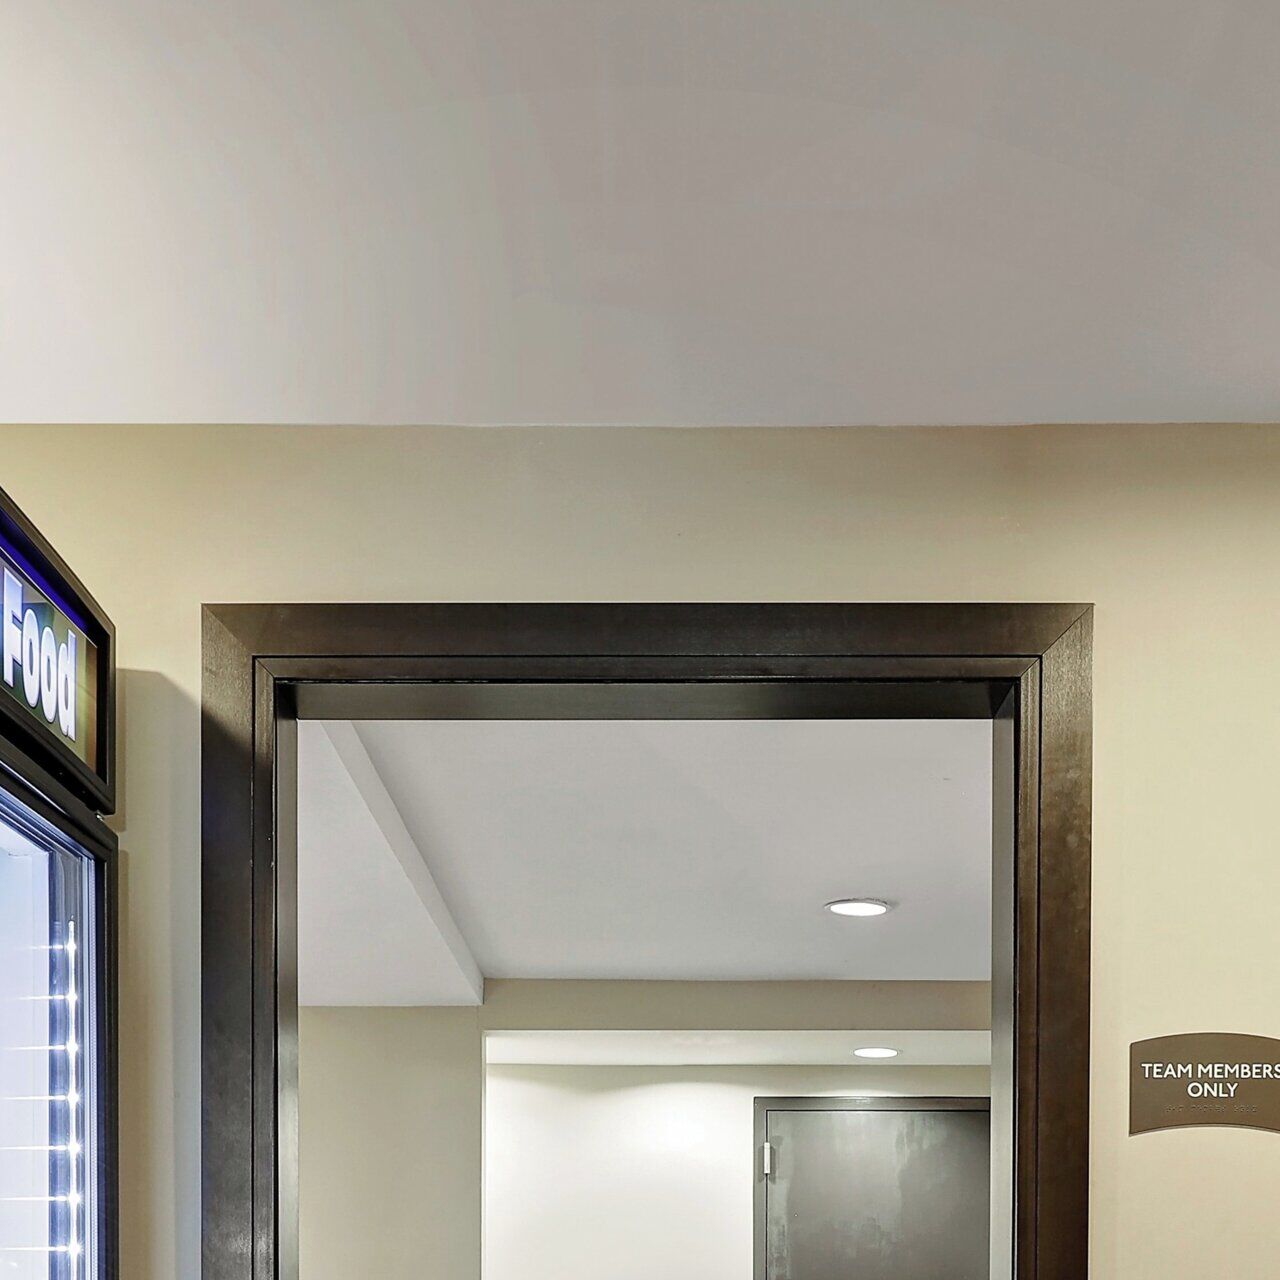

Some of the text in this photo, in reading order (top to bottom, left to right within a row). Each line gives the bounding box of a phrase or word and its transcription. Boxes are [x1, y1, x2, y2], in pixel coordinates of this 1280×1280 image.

[4, 567, 77, 742] Food
[1142, 1063, 1192, 1079] TEAM
[1187, 1082, 1239, 1098] ONLY
